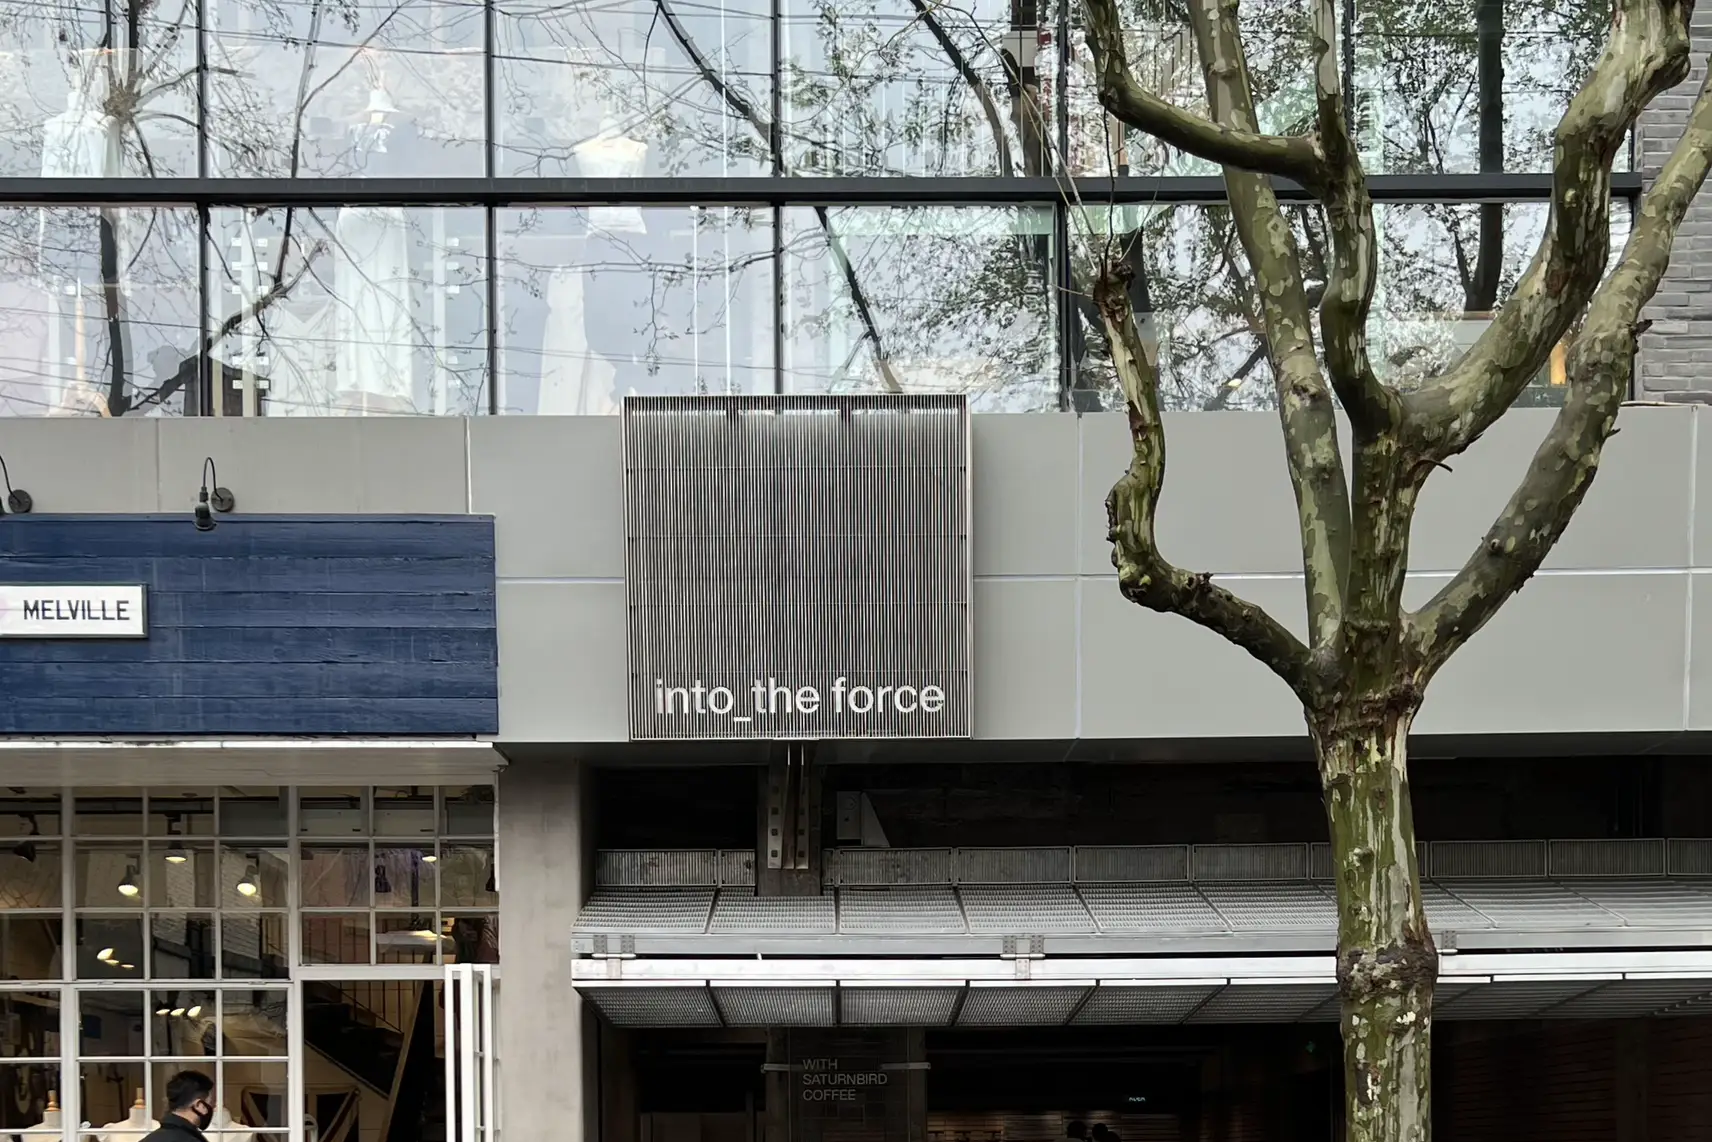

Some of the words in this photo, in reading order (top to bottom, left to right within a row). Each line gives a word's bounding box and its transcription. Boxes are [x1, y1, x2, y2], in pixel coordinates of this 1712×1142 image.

[23, 599, 130, 621] MELVILLE
[655, 676, 820, 722] into_the
[831, 676, 945, 713] force
[802, 1058, 838, 1070] WITH
[802, 1073, 888, 1085] SATURNBIRD
[802, 1089, 857, 1101] COFFEE
